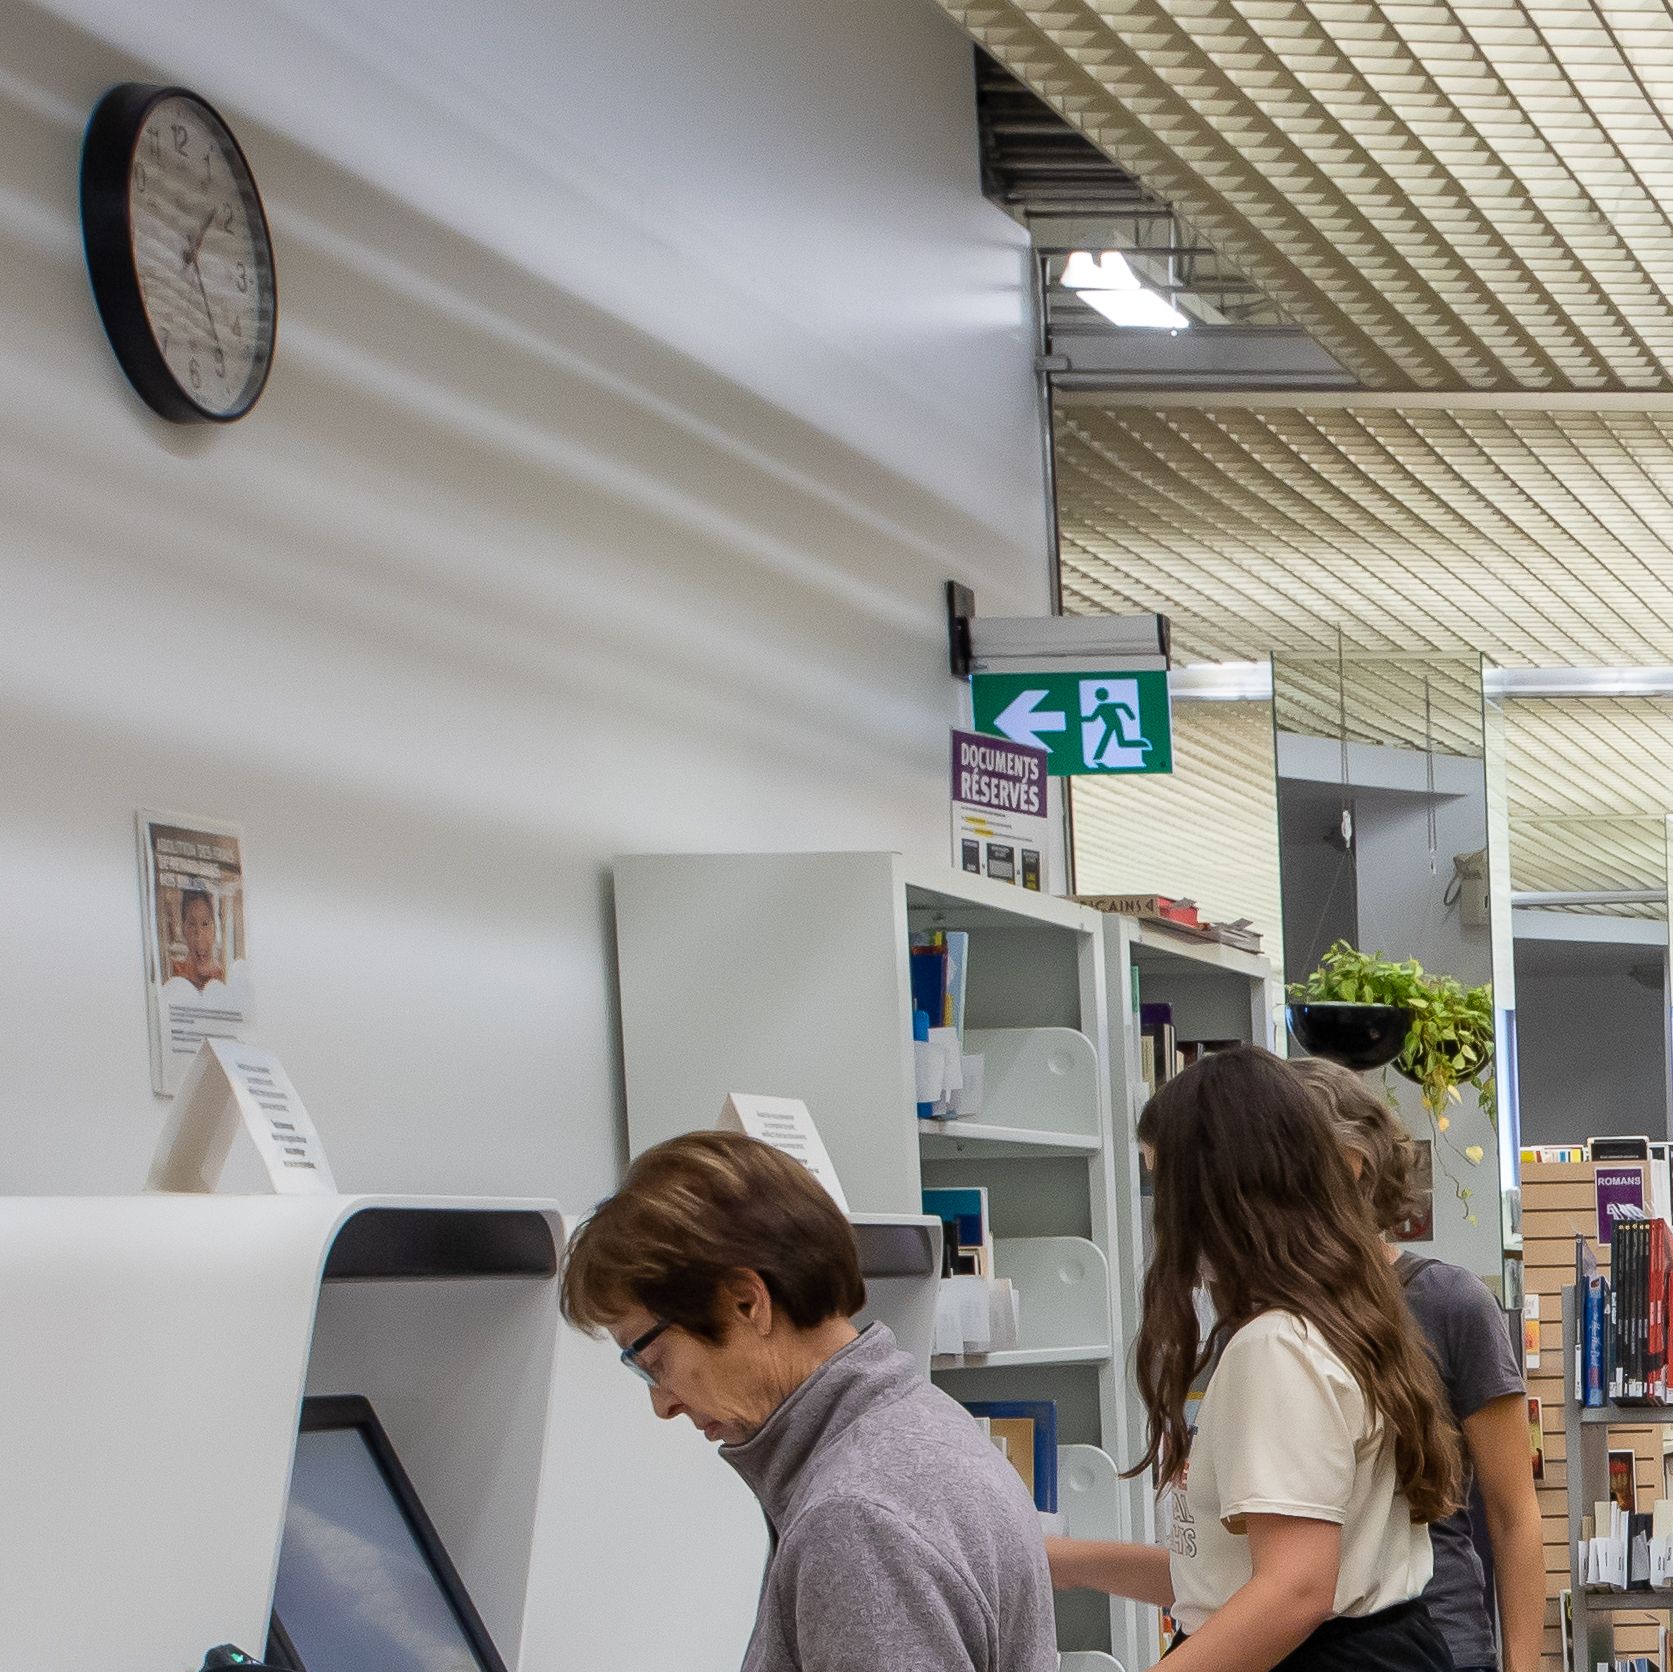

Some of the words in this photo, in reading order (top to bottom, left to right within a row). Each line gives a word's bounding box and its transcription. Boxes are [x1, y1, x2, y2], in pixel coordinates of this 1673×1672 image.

[170, 122, 189, 157] 12
[222, 202, 235, 234] 2
[237, 264, 248, 293] 3
[961, 742, 1039, 782] DOCUMENTS
[961, 768, 1039, 814] RÉSERVÉS
[1597, 1176, 1642, 1187] ROMANS
